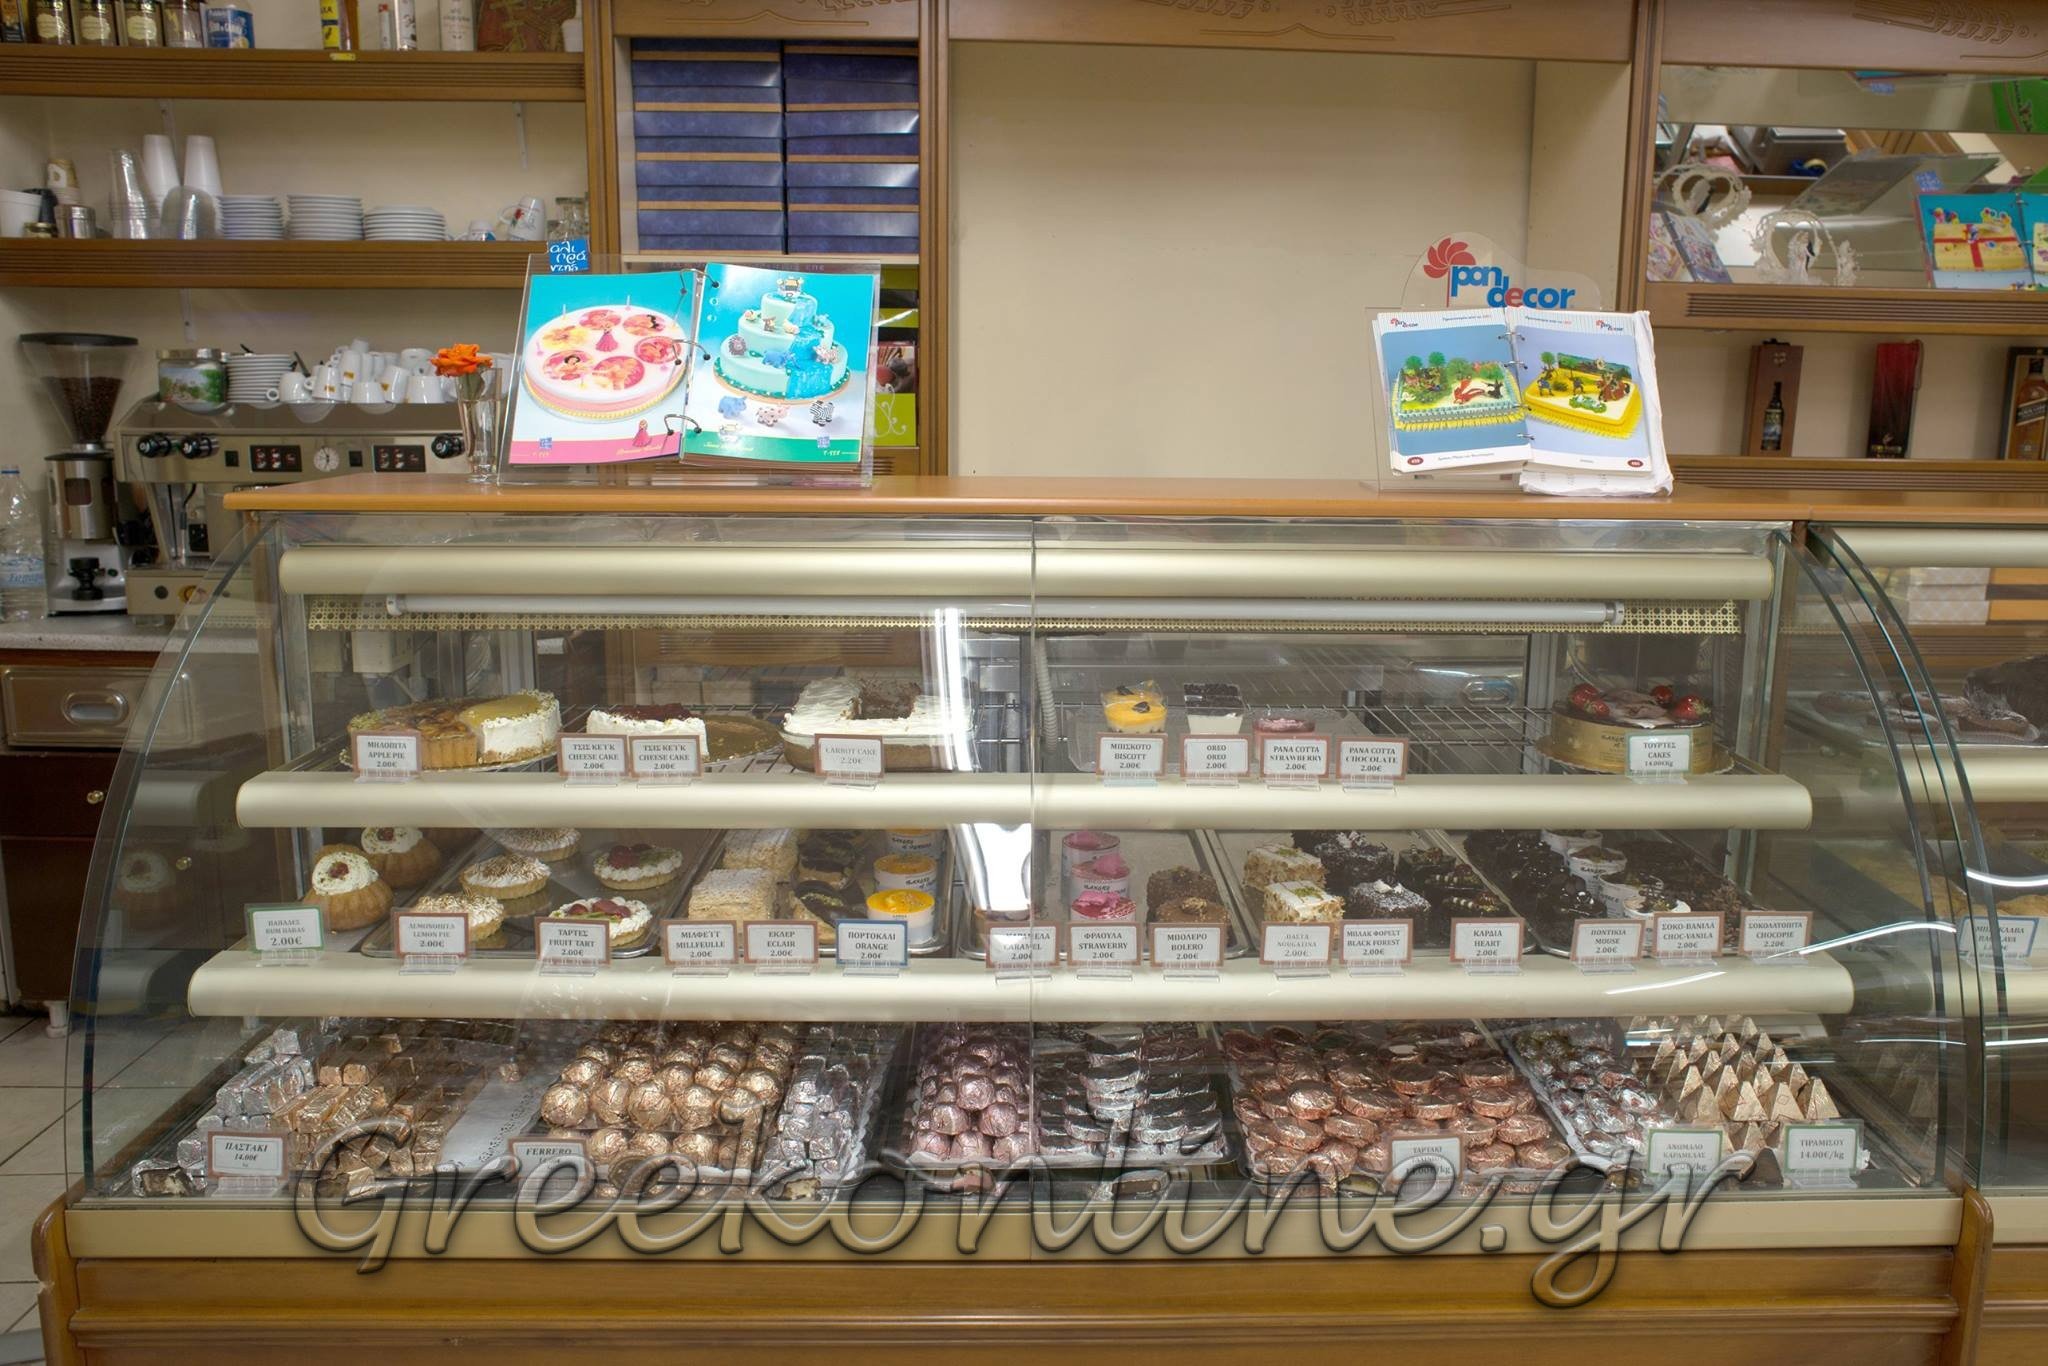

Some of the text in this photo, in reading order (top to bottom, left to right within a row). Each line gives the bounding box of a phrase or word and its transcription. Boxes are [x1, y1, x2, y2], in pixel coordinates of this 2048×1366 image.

[1450, 265, 1503, 297] pan
[1487, 276, 1575, 308] decor
[857, 747, 877, 756] CAKE
[1206, 744, 1227, 752] OREO
[1273, 745, 1320, 753] PANA COTTA
[1370, 747, 1396, 755] COTTA
[368, 751, 392, 759] APPLE
[568, 753, 619, 761] CHEESE CAKE
[638, 753, 690, 762] CHEESE CAKE
[1206, 753, 1227, 761] OREO
[583, 762, 605, 770] 2.00€
[653, 762, 676, 770] 2.00€
[1360, 764, 1382, 772] 2.00€
[558, 929, 589, 937] ΤΑΡΤΕΣ
[848, 932, 896, 940] ΠΟΡΤΟΚΑΛΙ
[1167, 933, 1208, 941] ΜΠΟΛΕΡΟ
[270, 936, 303, 946] 2.00€
[419, 940, 445, 948] 2.00€
[548, 939, 595, 948] FRUIT TART
[767, 940, 796, 948] ECLAIR
[855, 942, 888, 951] ORANGE
[561, 949, 584, 957] 2.00€
[690, 950, 713, 958] 2.00€
[770, 949, 793, 957] 2.00€
[861, 952, 883, 960] 2.00€
[1284, 949, 1309, 957] 2.00€
[1476, 949, 1497, 957] 2.00€
[1800, 1139, 1844, 1147] ΤΙΡΑΜΙΣΟΥ
[224, 1142, 269, 1153] ΠΑΣΤΑΚΙ
[526, 1147, 572, 1156] FERRERO
[1799, 1150, 1845, 1160] 14.00€/kg
